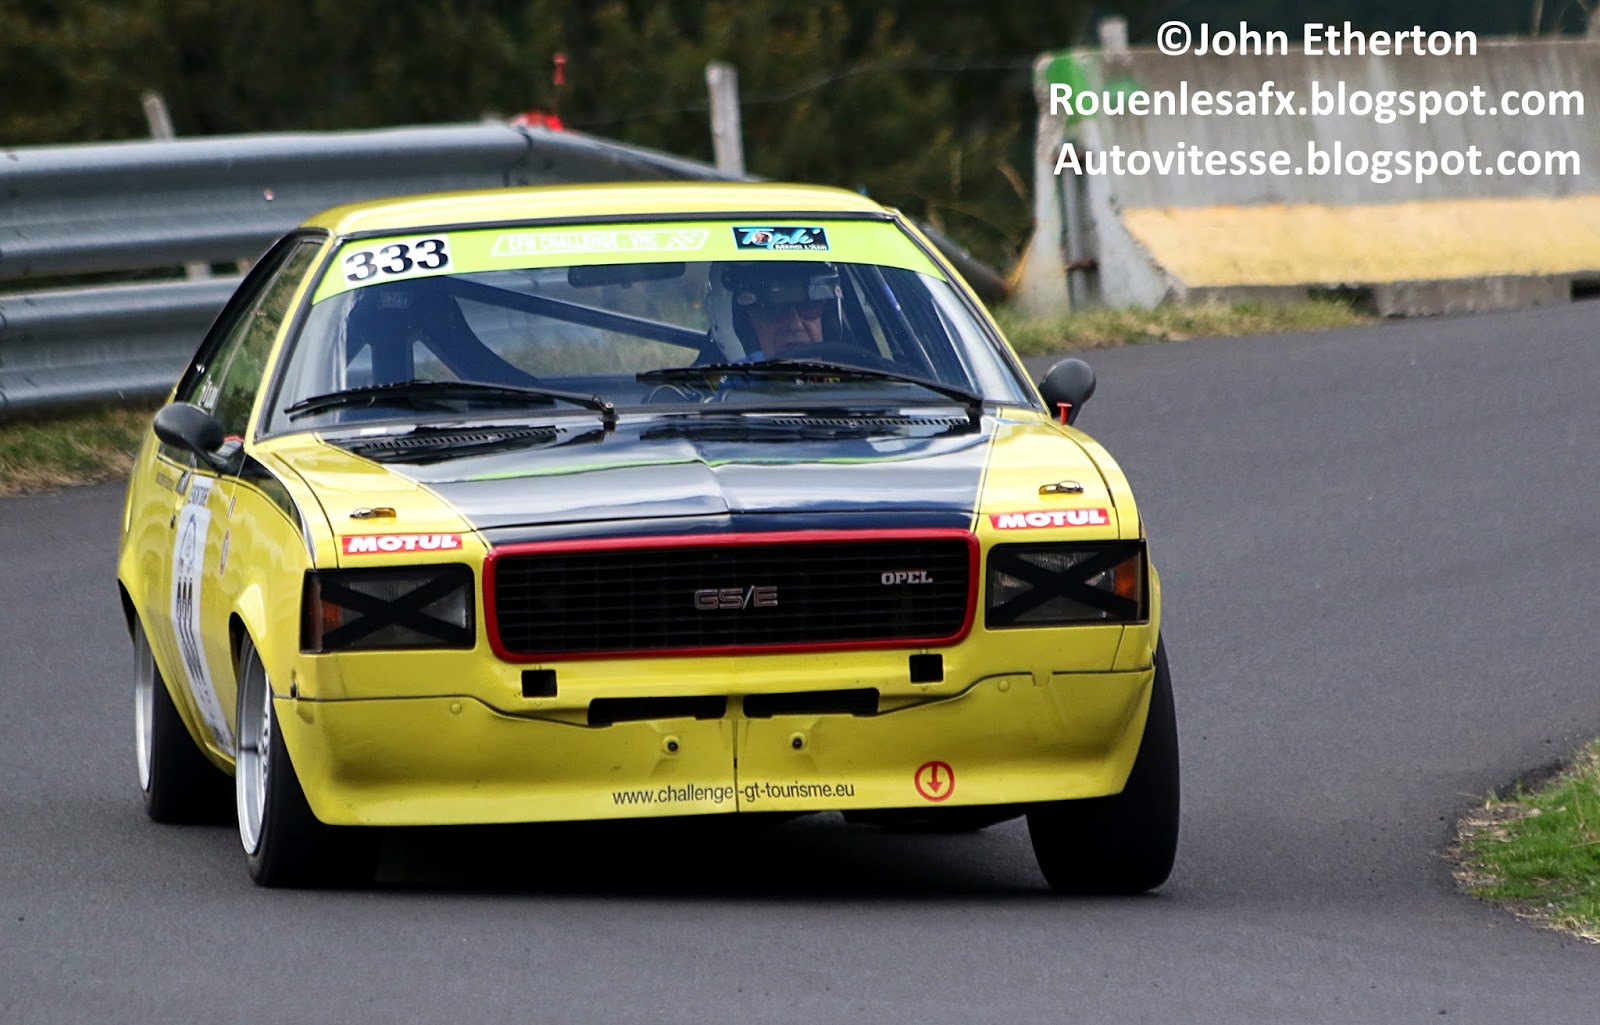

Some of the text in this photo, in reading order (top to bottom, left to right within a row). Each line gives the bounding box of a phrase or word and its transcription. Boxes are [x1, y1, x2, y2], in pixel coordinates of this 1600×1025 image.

[345, 238, 449, 282] 333
[998, 510, 1107, 529] MOTUL
[348, 535, 459, 553] MOTUL
[881, 571, 933, 585] OPEL
[694, 585, 778, 610] GS/E
[612, 781, 855, 805] www.challenge-gt-tourisme.eu
